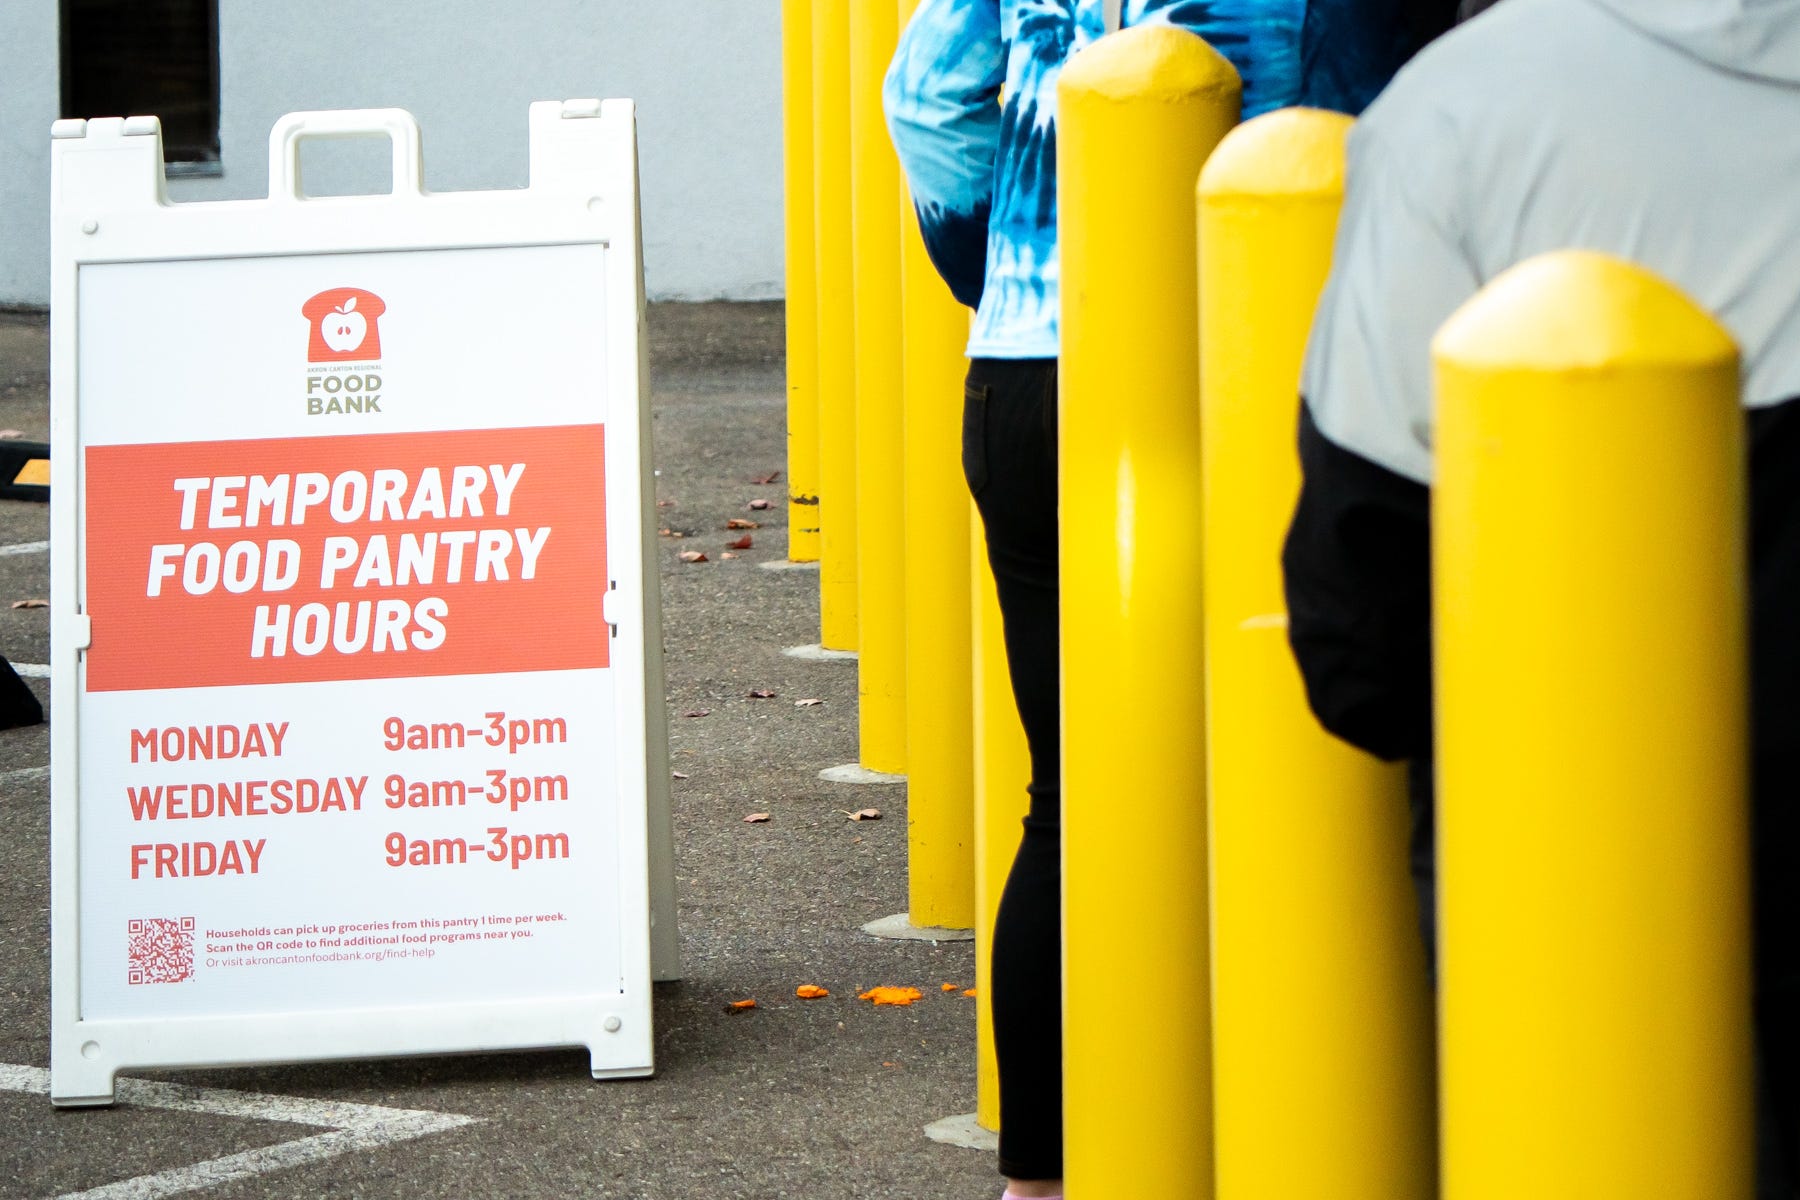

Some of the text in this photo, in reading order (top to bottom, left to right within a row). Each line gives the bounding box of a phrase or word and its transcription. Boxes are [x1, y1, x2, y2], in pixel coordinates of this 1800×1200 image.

[307, 374, 382, 394] FOOD
[307, 394, 382, 415] BANK
[173, 463, 526, 530] TEMPORARY
[146, 526, 552, 597] FOOD PANTRY
[251, 597, 449, 658] HOURS
[130, 711, 568, 763] MONDAY 9am-3pm
[126, 769, 569, 821] WEDNESDAY 9am-3pm
[130, 826, 570, 880] FRIDAY 9am-3pm
[205, 912, 568, 939] Households can pick up groceries from this pantry 1 time per week.
[205, 928, 534, 954] Scan the QR code to find additional food programs near you.
[205, 947, 436, 968] Or visit akroncantonfoodbank.org/find-help
